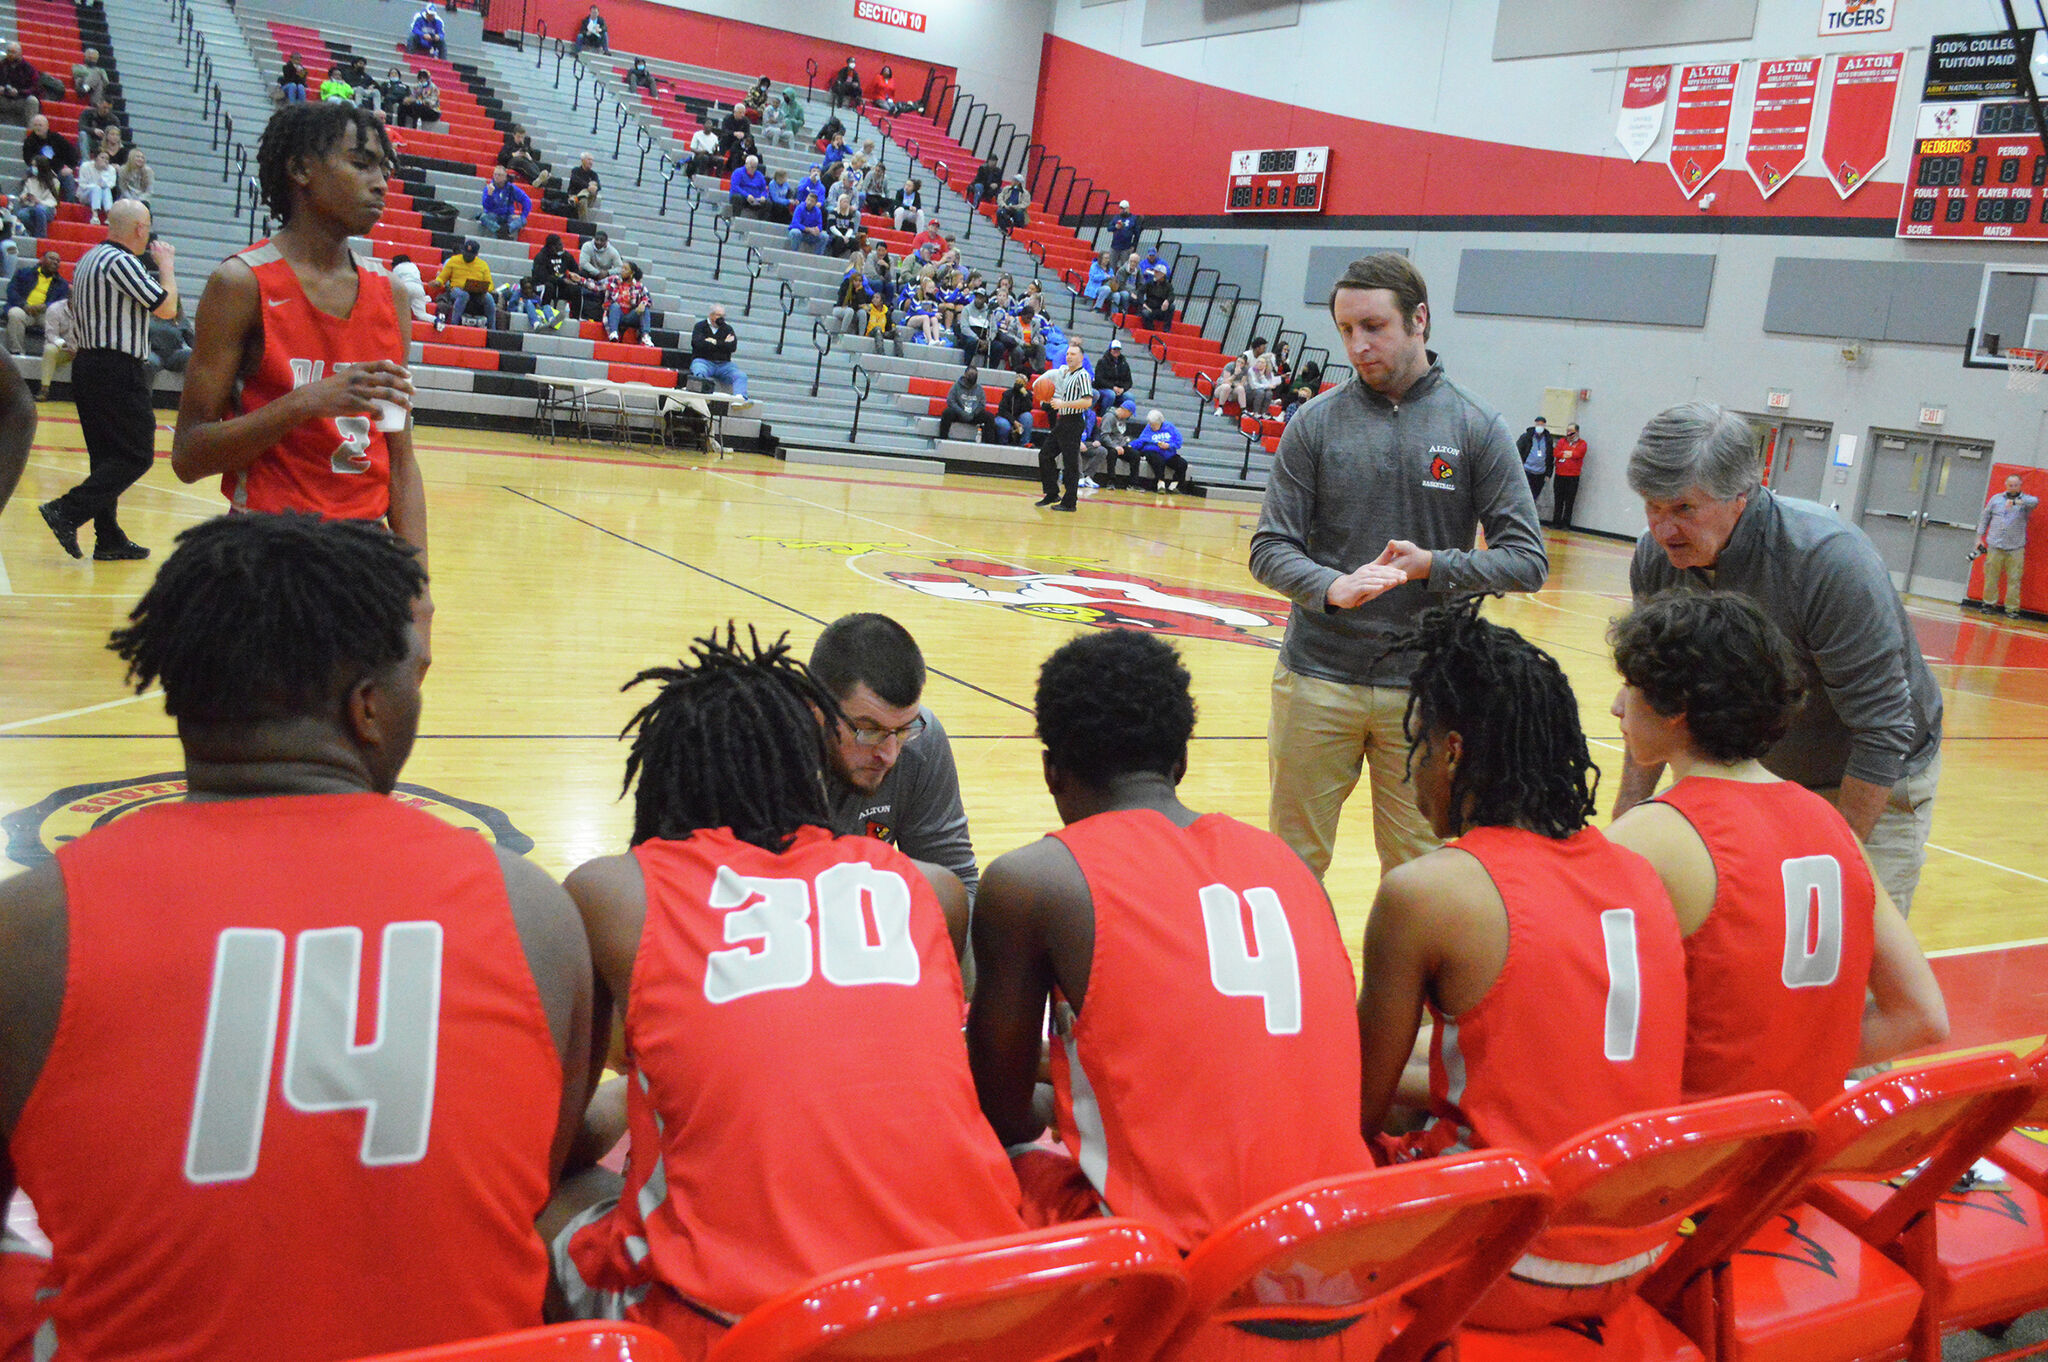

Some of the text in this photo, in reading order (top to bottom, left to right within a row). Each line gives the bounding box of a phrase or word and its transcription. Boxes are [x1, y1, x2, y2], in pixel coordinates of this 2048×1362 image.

[858, 1, 922, 30] SECTION 10
[1828, 8, 1886, 29] TIGERS
[1935, 41, 1968, 54] 100%
[1766, 61, 1813, 76] ALTON
[1844, 56, 1895, 71] ALTON
[1938, 54, 2016, 69] TUITION PAID
[1688, 65, 1732, 79] ALTON
[1926, 82, 2011, 93] ARMY NATIONAL GUARD
[1920, 140, 1974, 154] REDBIRDS
[1997, 146, 2029, 156] PERIOD
[1235, 175, 1252, 186] HOME
[1297, 174, 1318, 184] GUEST
[1913, 188, 1939, 198] FOULS
[1977, 188, 2033, 198] PLAYER FOUL
[1906, 225, 1934, 235] SCORE
[1983, 226, 2013, 236] MATCH
[1770, 394, 1785, 406] EXIT
[1923, 409, 1940, 422] EXIT
[331, 416, 371, 474] 2
[1428, 445, 1460, 457] ALTON
[858, 804, 891, 820] ALTON
[1781, 853, 1842, 989] 0
[703, 860, 921, 1006] 30
[1198, 883, 1303, 1036] 4
[1599, 907, 1642, 1061] 1
[184, 920, 443, 1184] 14
